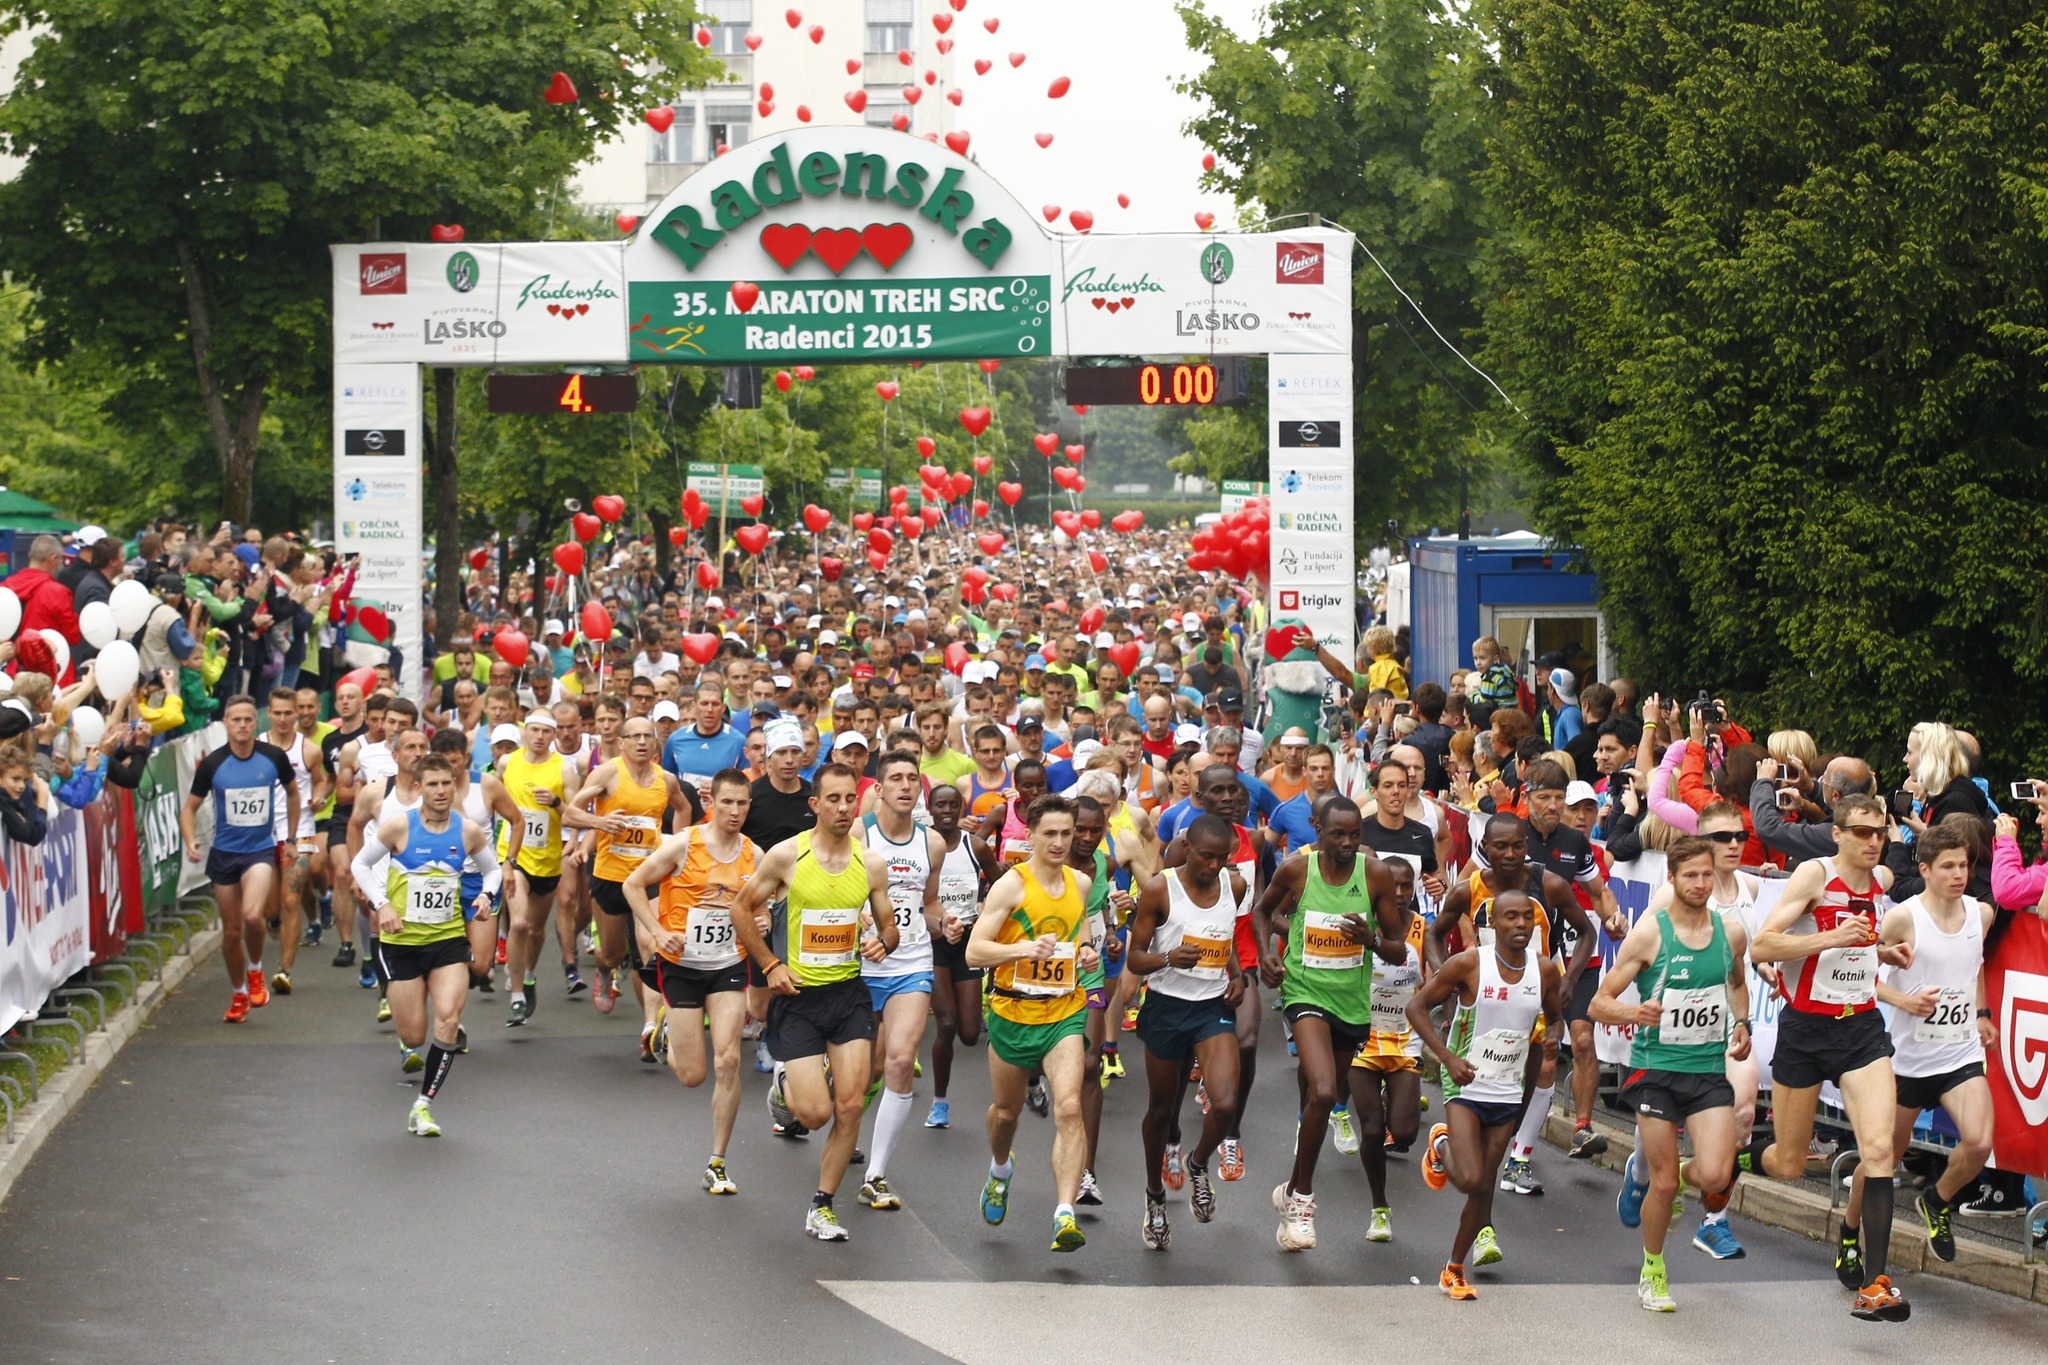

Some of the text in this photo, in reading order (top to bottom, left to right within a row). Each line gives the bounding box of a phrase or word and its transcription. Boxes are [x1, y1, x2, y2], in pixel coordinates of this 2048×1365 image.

[650, 142, 1013, 272] Radenska
[1279, 254, 1319, 276] Union
[362, 265, 402, 287] Union
[516, 274, 620, 311] Radenska
[1061, 267, 1166, 305] Radenska
[673, 291, 716, 317] 35.
[870, 288, 941, 314] TREH
[948, 286, 1005, 312] SRC
[1185, 298, 1248, 308] PIVOVARNA
[1176, 309, 1260, 336] LAŠKO
[424, 318, 507, 345] LAŠKO
[746, 322, 933, 351] Radenci 2015
[1205, 337, 1229, 346] 1825
[1140, 365, 1215, 405] 0.00
[1294, 379, 1341, 388] REFLEX
[360, 388, 406, 397] REFLEX
[372, 481, 406, 489] Telekom
[1307, 473, 1342, 482] Telekom
[1224, 481, 1250, 491] CONA
[359, 519, 400, 529] OBČINA
[1297, 511, 1338, 521] OBČINA
[360, 530, 404, 539] RADENCI
[1297, 523, 1342, 532] RADENCI
[367, 558, 406, 568] Fundacija
[1304, 551, 1343, 561] Fundacija
[1302, 594, 1342, 610] triglav
[231, 799, 265, 815] 1267
[526, 822, 543, 837] 16
[625, 829, 644, 845] 20
[886, 856, 922, 873] adenska
[414, 890, 452, 909] 1826
[938, 890, 974, 903] pkosgei
[893, 907, 912, 927] 63
[694, 924, 734, 944] 1535
[811, 931, 851, 944] Kosovelj
[1030, 960, 1065, 982] 156
[1831, 969, 1867, 981] Kotnik
[1371, 1003, 1403, 1015] ukuria
[1670, 1004, 1720, 1028] 1065
[1924, 1002, 1970, 1025] 2265
[1482, 1048, 1522, 1064] Mwangi
